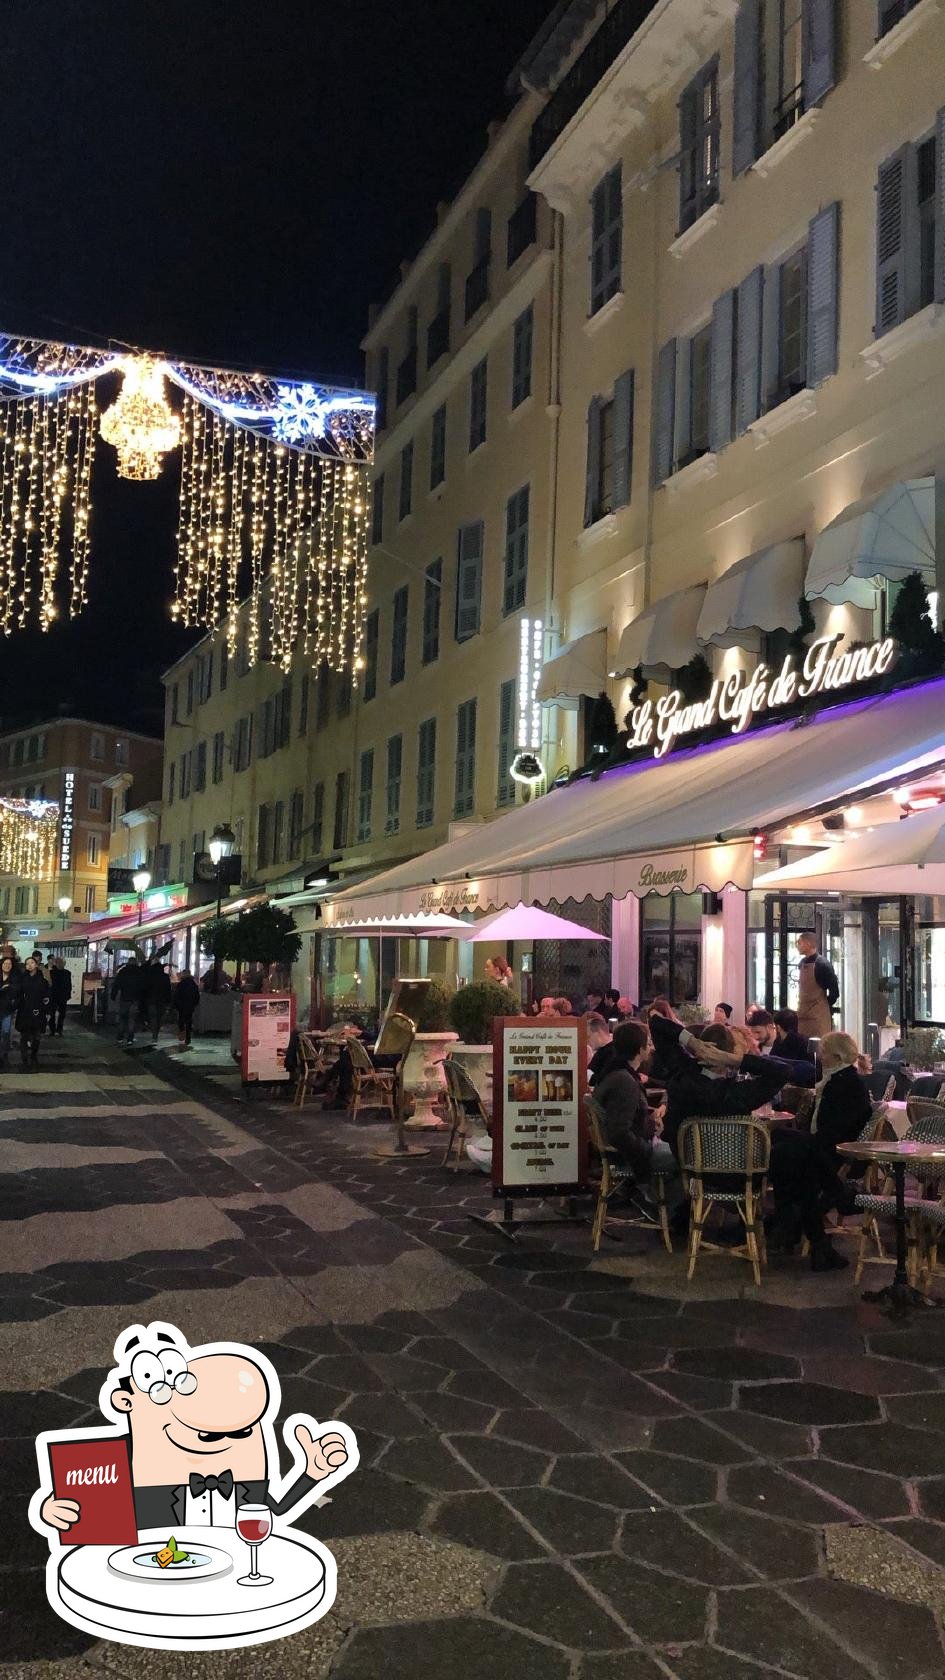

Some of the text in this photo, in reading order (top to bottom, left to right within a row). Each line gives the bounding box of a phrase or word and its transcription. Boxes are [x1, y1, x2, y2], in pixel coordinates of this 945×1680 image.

[627, 632, 894, 759] Le Grand Café de France
[64, 773, 75, 813] HOTEL
[638, 863, 688, 886] Brasserie
[509, 1045, 572, 1055] HAPPY HOUR
[513, 1055, 569, 1065] EVERY DAY
